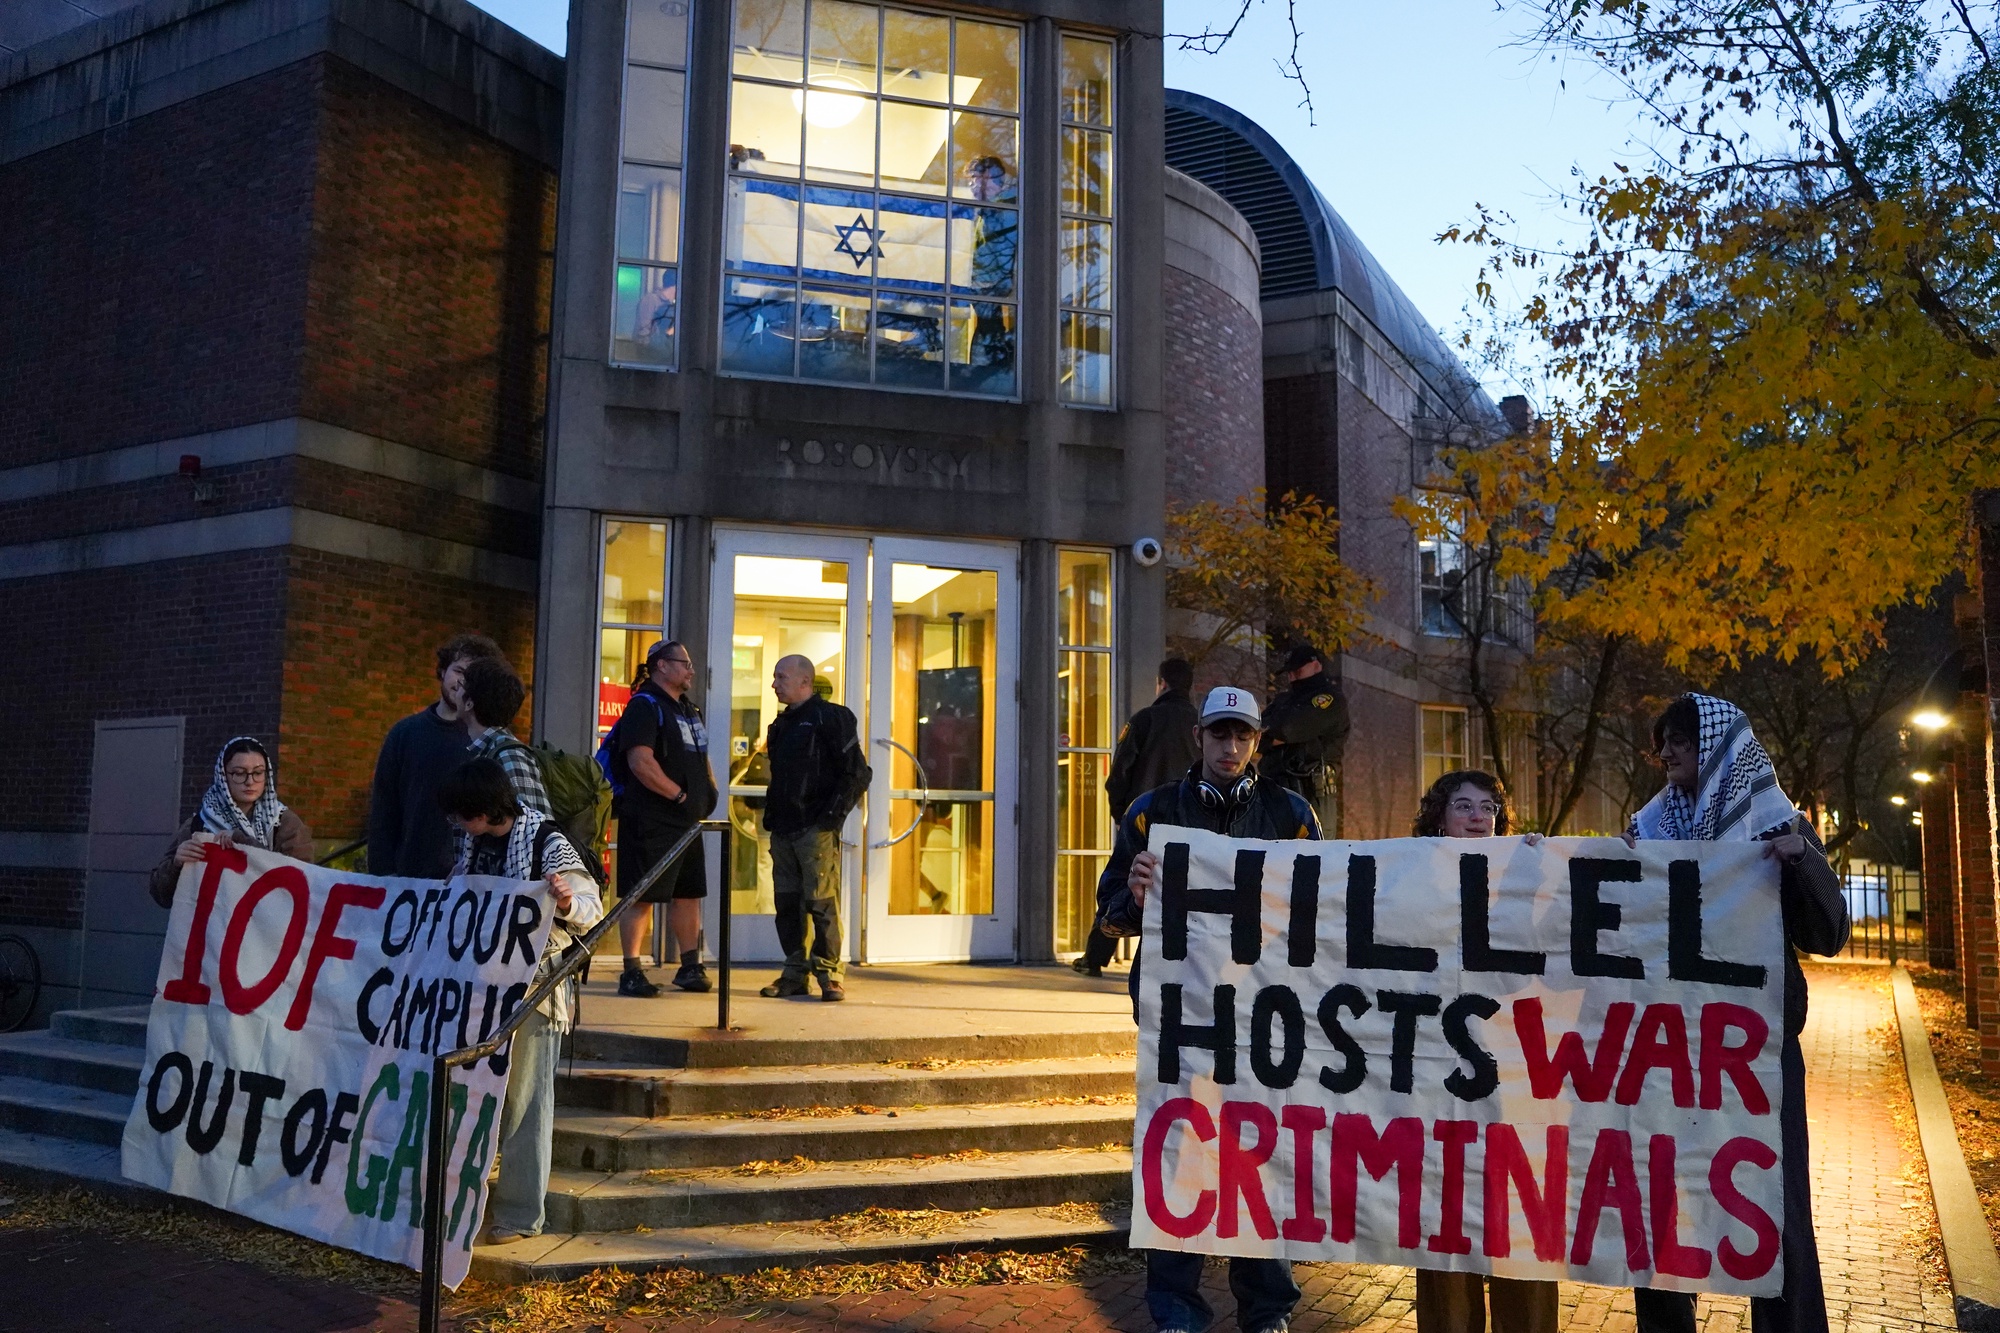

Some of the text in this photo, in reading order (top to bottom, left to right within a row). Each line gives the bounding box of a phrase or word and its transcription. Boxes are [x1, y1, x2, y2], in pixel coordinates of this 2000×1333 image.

[776, 436, 971, 477] ROSOVSKY
[1225, 692, 1238, 707] B
[164, 842, 386, 1031] IOF
[381, 888, 542, 966] OFF OUR
[1161, 842, 1767, 989] HILLEL
[357, 966, 529, 1077] CAMPUS
[1158, 983, 1770, 1115] HOSTS WAR
[146, 1051, 286, 1167] OUT
[281, 1089, 359, 1185] OF
[1142, 1097, 1779, 1281] CRIMINALS
